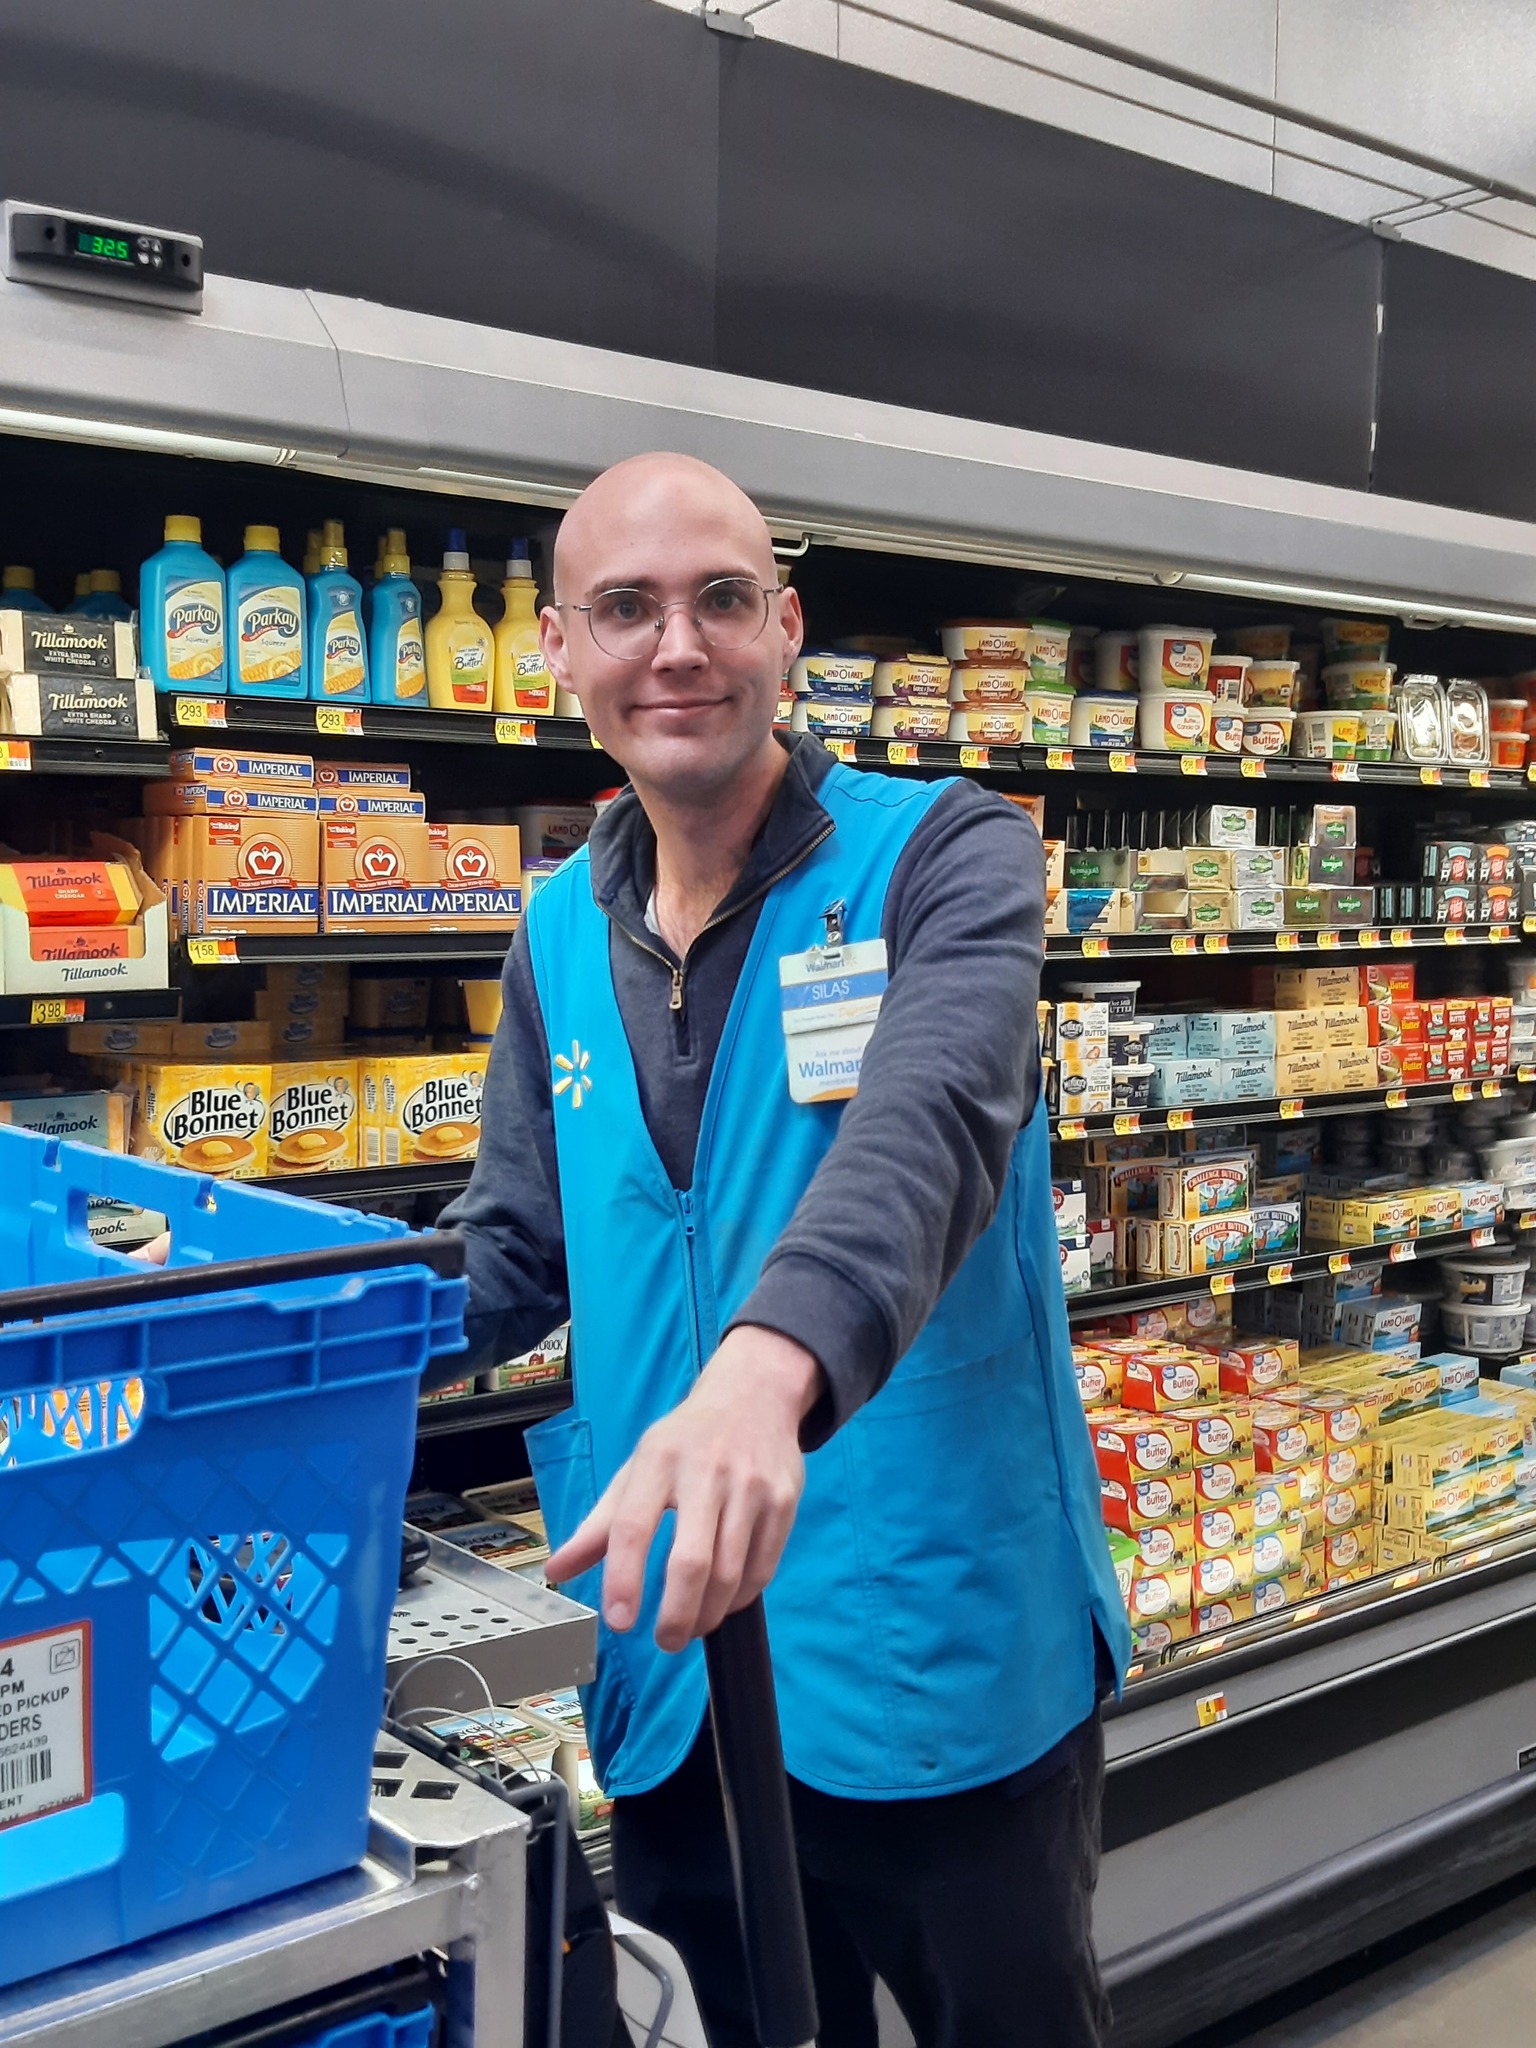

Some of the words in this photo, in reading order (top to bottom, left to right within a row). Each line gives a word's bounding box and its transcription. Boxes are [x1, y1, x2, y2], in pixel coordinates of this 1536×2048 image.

[173, 604, 218, 631] Parkay
[248, 608, 297, 634] Parkay
[31, 631, 108, 650] Tillamook
[185, 635, 209, 645] Squeeze
[261, 638, 287, 647] Squeeze
[329, 636, 360, 655] Parkay
[44, 655, 66, 664] WHITE
[66, 657, 97, 667] CHEDDAR
[454, 653, 485, 670] Butter!
[48, 693, 128, 711] Tillamook
[62, 717, 84, 725] WHITE
[85, 718, 117, 726] CHEDDAR
[89, 712, 112, 720] SHARP
[1252, 735, 1281, 745] Butter
[249, 760, 303, 776] IMPERIAL
[349, 771, 400, 783] IMPERIAL
[257, 794, 309, 810] IMPERIAL
[367, 799, 416, 813] IMPERIAL
[26, 872, 104, 890] Tillamook
[212, 889, 316, 914] IMPERIAL
[332, 891, 428, 914] IMPERIAL
[430, 892, 520, 914] MPERIAL
[61, 963, 128, 982] Tillamook
[806, 959, 845, 974] Walmart
[1316, 972, 1351, 988] Tillamook
[1390, 981, 1410, 990] Butter
[812, 980, 850, 1000] SILAS
[1231, 1020, 1267, 1036] Tillamook
[1288, 1016, 1319, 1031] Tillamook
[1324, 1014, 1360, 1030] Tillamook
[1402, 1020, 1420, 1031] Butter
[799, 1060, 863, 1079] Walmar
[1288, 1060, 1320, 1076] Tillamook
[1338, 1055, 1370, 1070] Tillamook
[1403, 1061, 1422, 1071] Butter
[1175, 1068, 1213, 1085] Tillamook
[1231, 1063, 1267, 1080] Tillamook
[287, 1085, 333, 1112] Blue
[425, 1081, 468, 1105] Blue
[191, 1089, 242, 1115] Blue
[272, 1102, 349, 1136] Bonnet
[411, 1096, 483, 1130] Bonnet
[173, 1109, 259, 1142] Bonnet
[1189, 1169, 1220, 1187] CHALLENGE
[1221, 1168, 1243, 1181] BUTTER
[1195, 1224, 1227, 1242] CHALLENGE
[1227, 1222, 1249, 1234] BUTTER
[1260, 1364, 1278, 1375] Butter
[1172, 1378, 1195, 1389] Butter
[1208, 1432, 1229, 1444] Butter
[1146, 1447, 1168, 1459] Butter
[1211, 1476, 1231, 1488] Butter
[1147, 1494, 1168, 1506] Butter
[1258, 1503, 1277, 1515] Butter
[1211, 1524, 1231, 1536] Butter
[1150, 1541, 1170, 1554] Butter
[1208, 1617, 1228, 1629] Butter
[1146, 1635, 1168, 1647] Butter
[17, 1686, 70, 1713] PICKUP
[545, 1700, 581, 1715] COUNT
[0, 1714, 42, 1741] DERS
